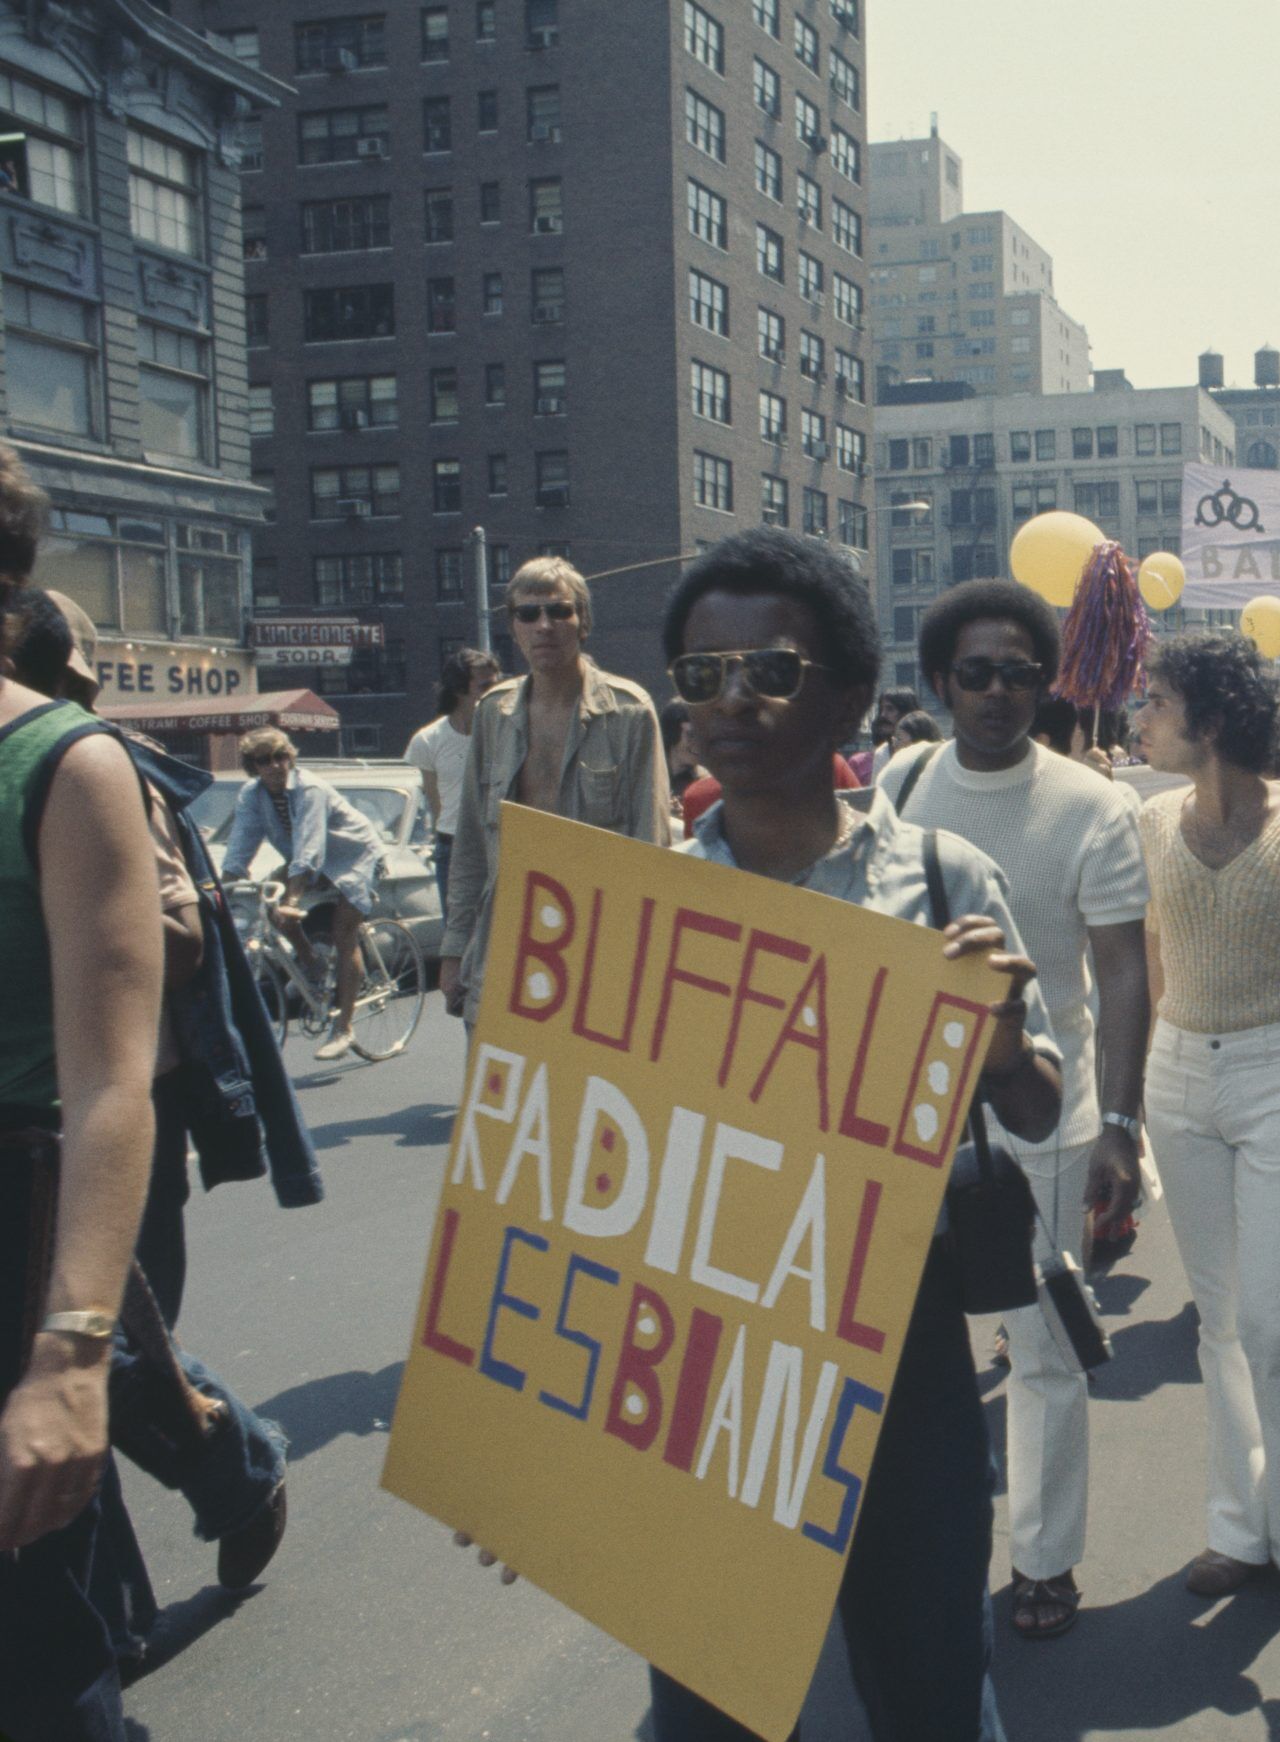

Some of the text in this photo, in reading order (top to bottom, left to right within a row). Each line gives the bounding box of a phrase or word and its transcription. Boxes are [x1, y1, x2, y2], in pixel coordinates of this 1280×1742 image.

[89, 661, 240, 695] FEE SHOP
[188, 717, 232, 729] COFFEE
[239, 713, 270, 727] SHOP
[276, 649, 341, 663] SODA
[510, 870, 982, 1168] BUFFALO
[450, 1042, 884, 1353] RADICAL
[421, 1207, 886, 1554] LESBIANS
